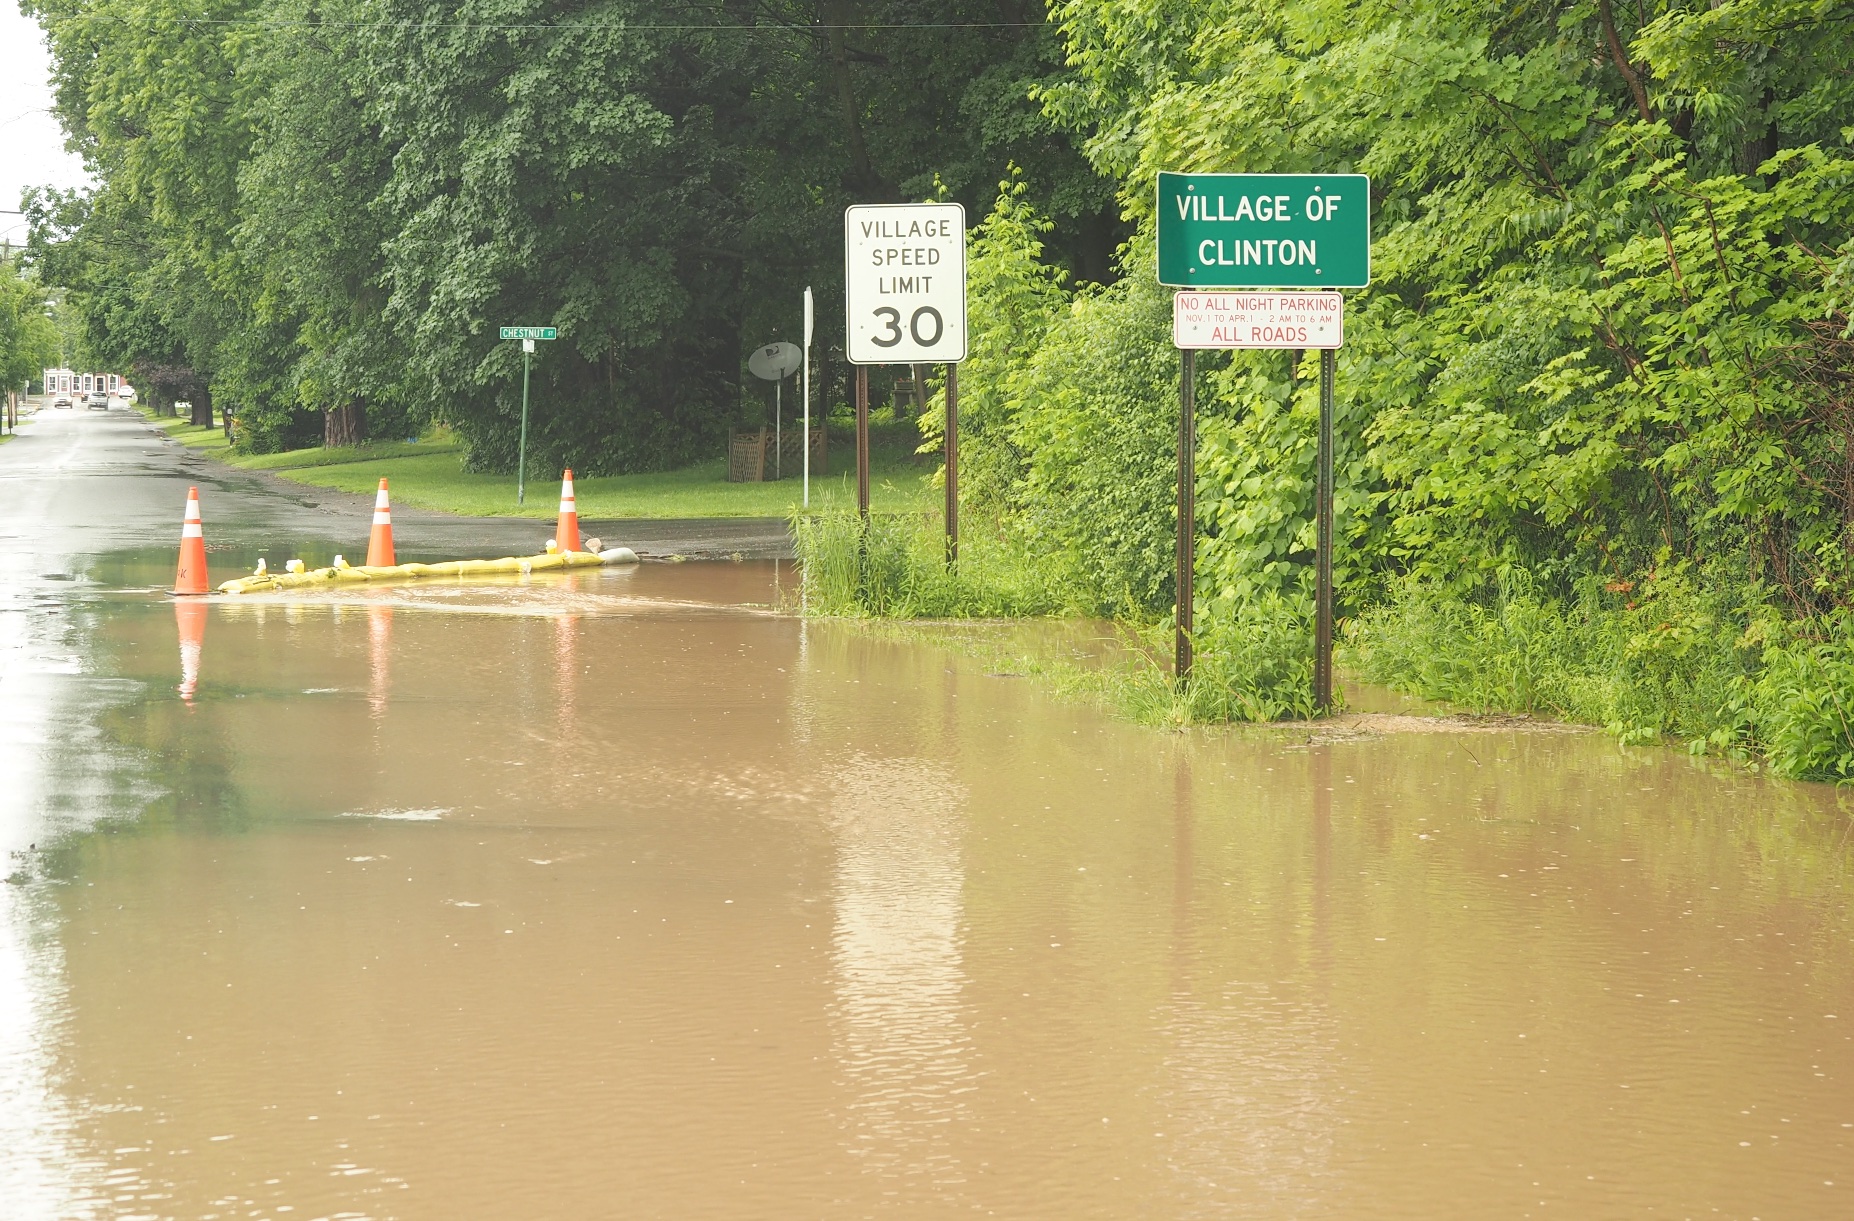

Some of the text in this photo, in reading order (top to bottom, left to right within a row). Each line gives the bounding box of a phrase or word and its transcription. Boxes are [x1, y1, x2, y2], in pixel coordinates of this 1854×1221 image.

[1176, 195, 1342, 221] VILLAGE OF
[860, 219, 951, 238] VILLAGE
[872, 248, 940, 266] SPEED
[1198, 239, 1316, 266] CLINTON
[879, 276, 933, 294] LIMIT
[1180, 297, 1337, 311] NO ALL NIGHT PARKING
[870, 305, 944, 348] 30
[1214, 314, 1225, 323] TO
[1269, 314, 1275, 323] 2
[1278, 315, 1292, 323] AM
[1295, 315, 1306, 323] TO
[1309, 315, 1316, 323] 6
[1319, 315, 1332, 323] AM
[503, 328, 545, 338] CHESTNUT
[1211, 326, 1307, 342] ALL ROADS
